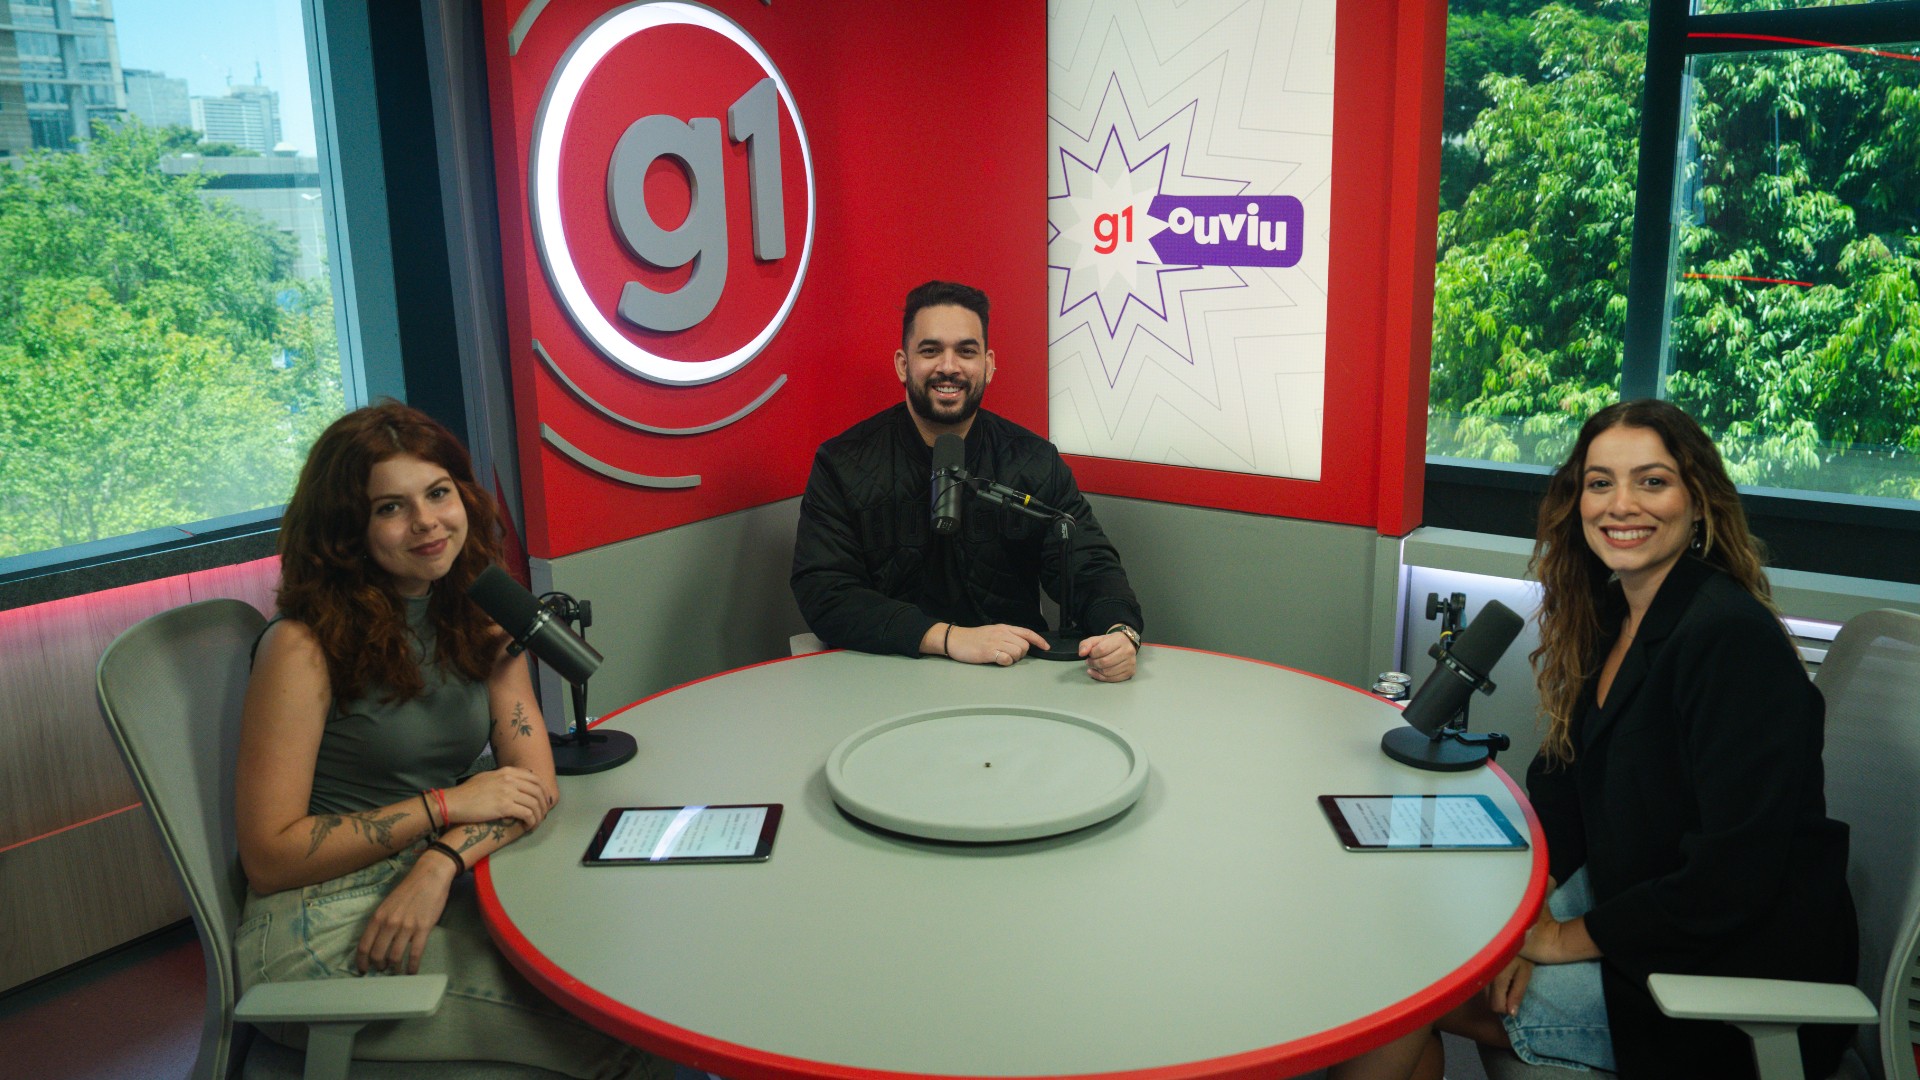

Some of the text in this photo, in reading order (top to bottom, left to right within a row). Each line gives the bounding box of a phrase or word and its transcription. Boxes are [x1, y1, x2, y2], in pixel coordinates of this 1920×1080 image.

[607, 77, 786, 331] g1
[1093, 203, 1287, 254] g1 ouviu
